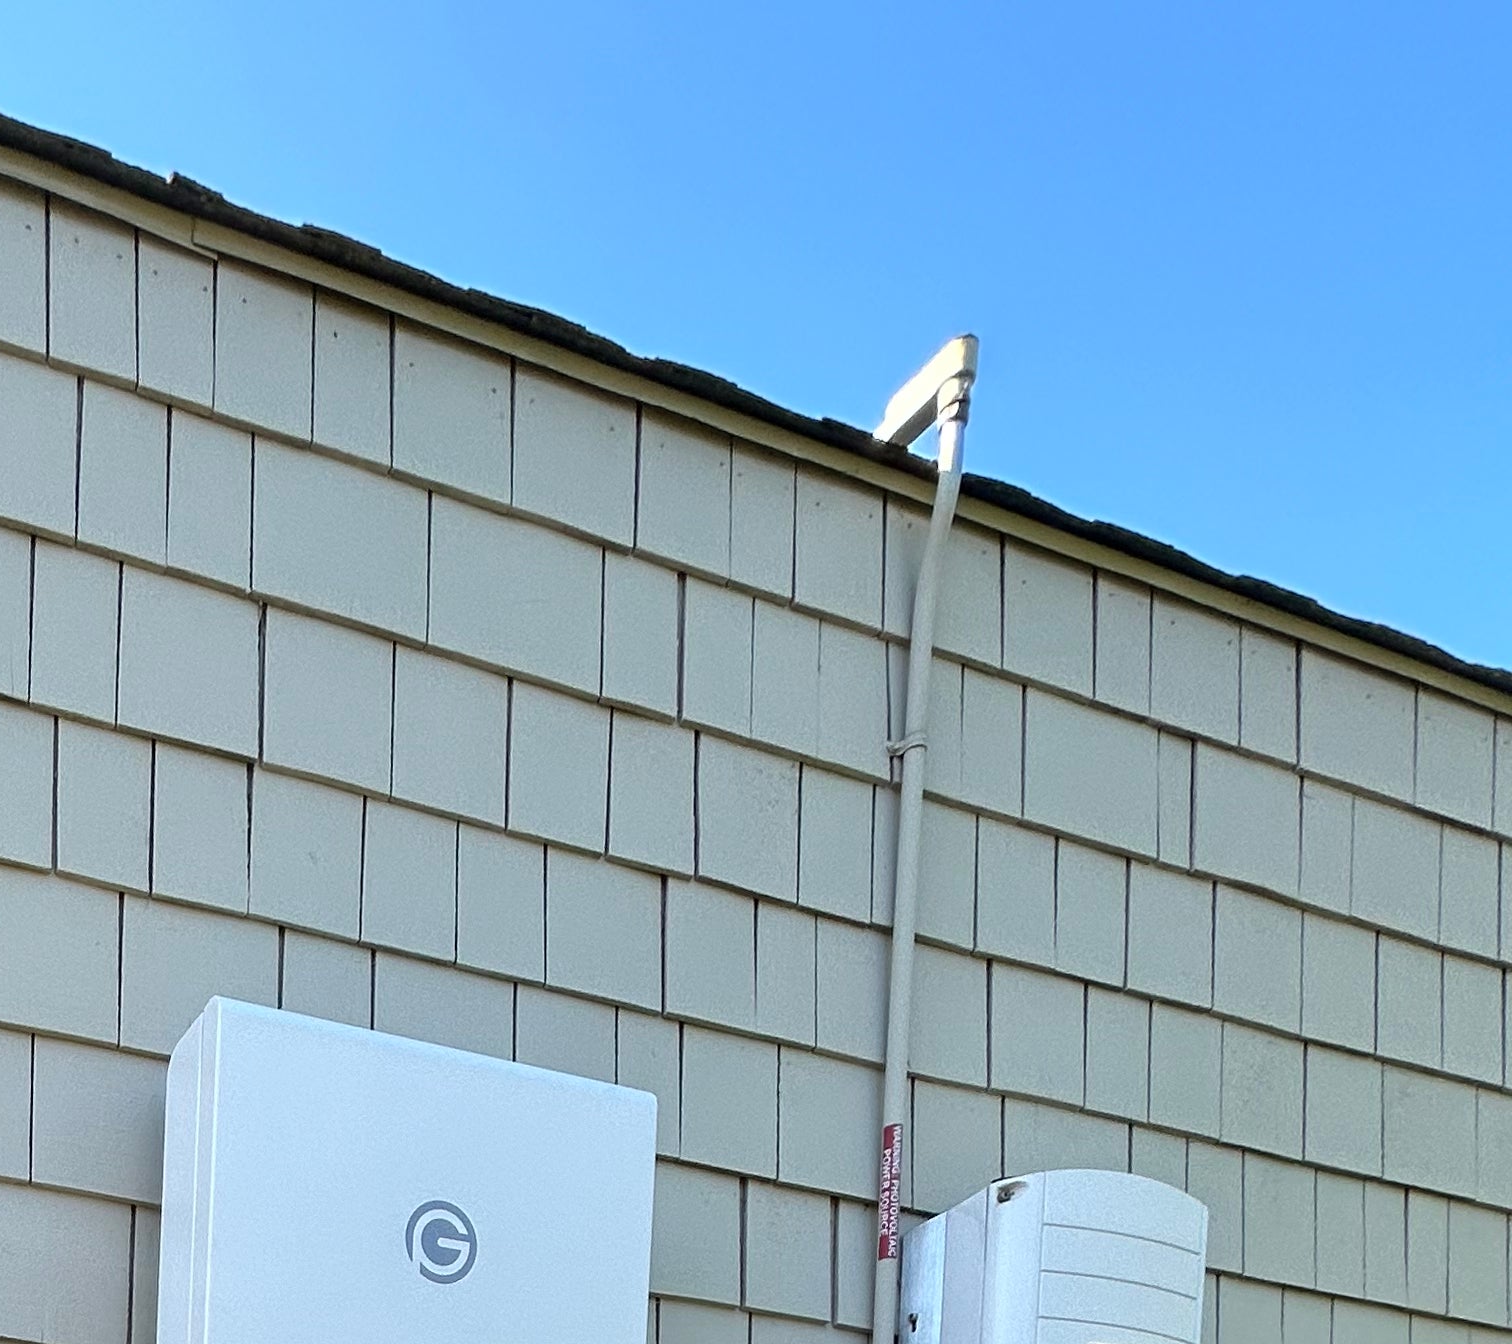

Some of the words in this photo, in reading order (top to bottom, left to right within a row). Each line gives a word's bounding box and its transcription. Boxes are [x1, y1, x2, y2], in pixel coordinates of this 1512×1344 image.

[882, 1148, 892, 1188] POWER
[880, 1190, 890, 1235] SOURCE
[888, 1180, 900, 1257] PHOTOVOLTAIC
